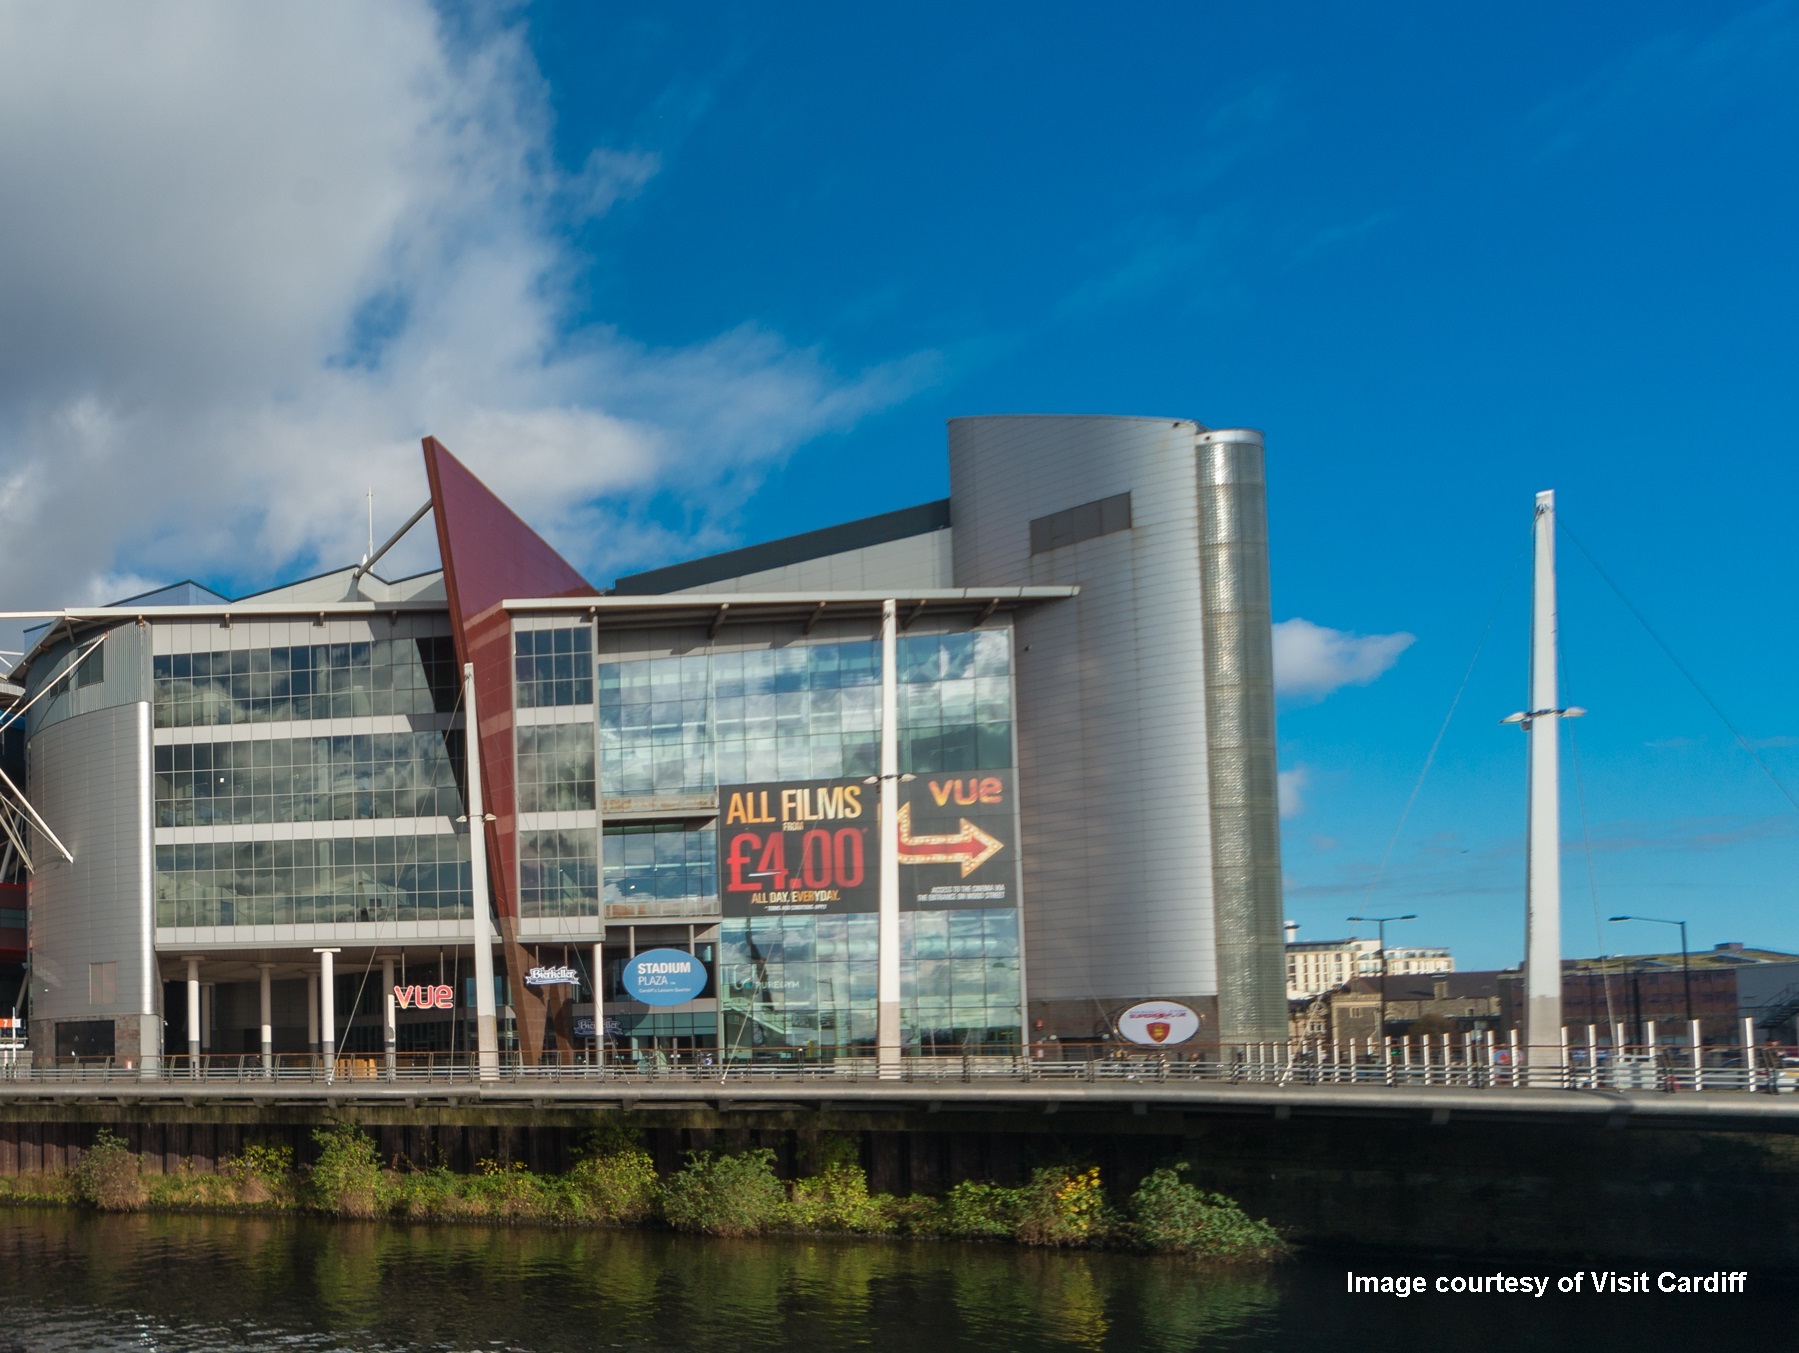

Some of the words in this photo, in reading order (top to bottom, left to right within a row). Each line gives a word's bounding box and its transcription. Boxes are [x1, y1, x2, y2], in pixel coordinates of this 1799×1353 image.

[928, 777, 1003, 807] vue
[726, 790, 776, 825] ALL
[782, 785, 862, 822] FILMS
[783, 821, 804, 831] FROM
[953, 885, 960, 893] TO
[972, 884, 994, 892] CINEMA
[751, 892, 768, 904] ALL
[769, 891, 790, 903] DAY.
[791, 889, 841, 903] EVERYDAY.
[928, 893, 956, 901] ENTRANCE
[984, 891, 1005, 899] STREET
[531, 966, 575, 979] Bierkeller
[638, 962, 691, 974] STADIUM
[638, 975, 668, 986] PLAZA
[756, 980, 800, 989] PUREGYM
[393, 984, 454, 1009] vue
[3, 1019, 8, 1027] 7
